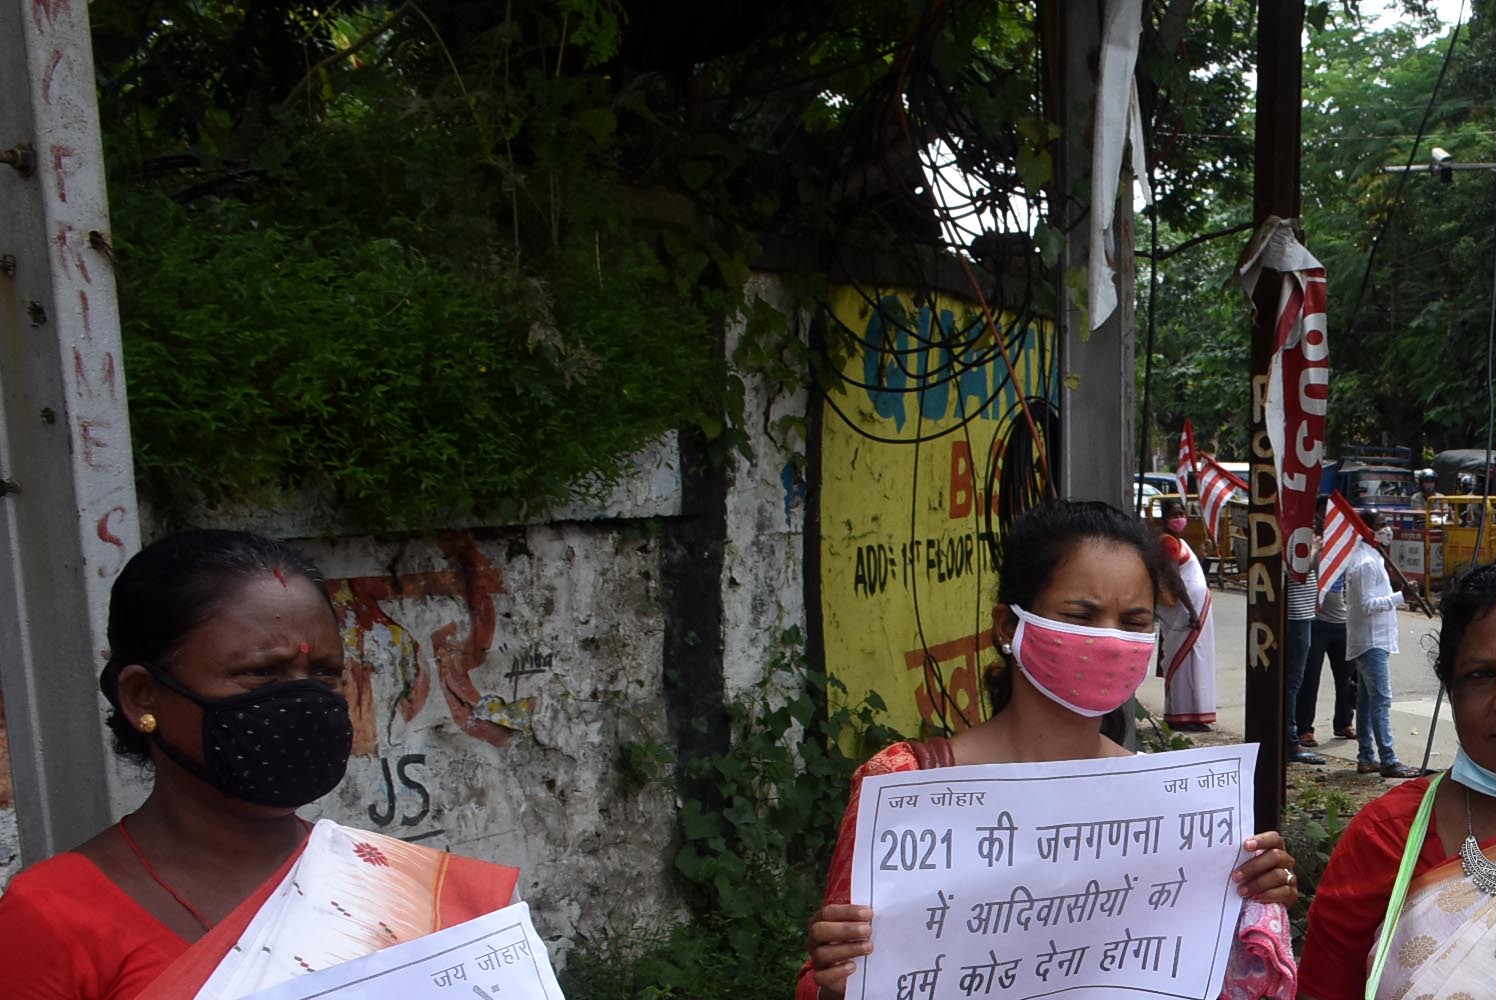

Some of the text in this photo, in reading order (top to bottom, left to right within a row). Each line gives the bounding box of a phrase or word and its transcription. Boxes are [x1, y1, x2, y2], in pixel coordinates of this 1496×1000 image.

[926, 533, 974, 585] FLOOR
[368, 753, 430, 827] JS
[888, 786, 986, 810] जय जोहार
[1163, 768, 1238, 795] जय जोहार
[879, 805, 1235, 871] 2021 की जनगणना प्रपत्र
[926, 866, 1189, 939] में आदिवासीयों को
[431, 938, 531, 992] जय जोहार
[958, 950, 1022, 996] कोड
[1034, 938, 1090, 982] देना
